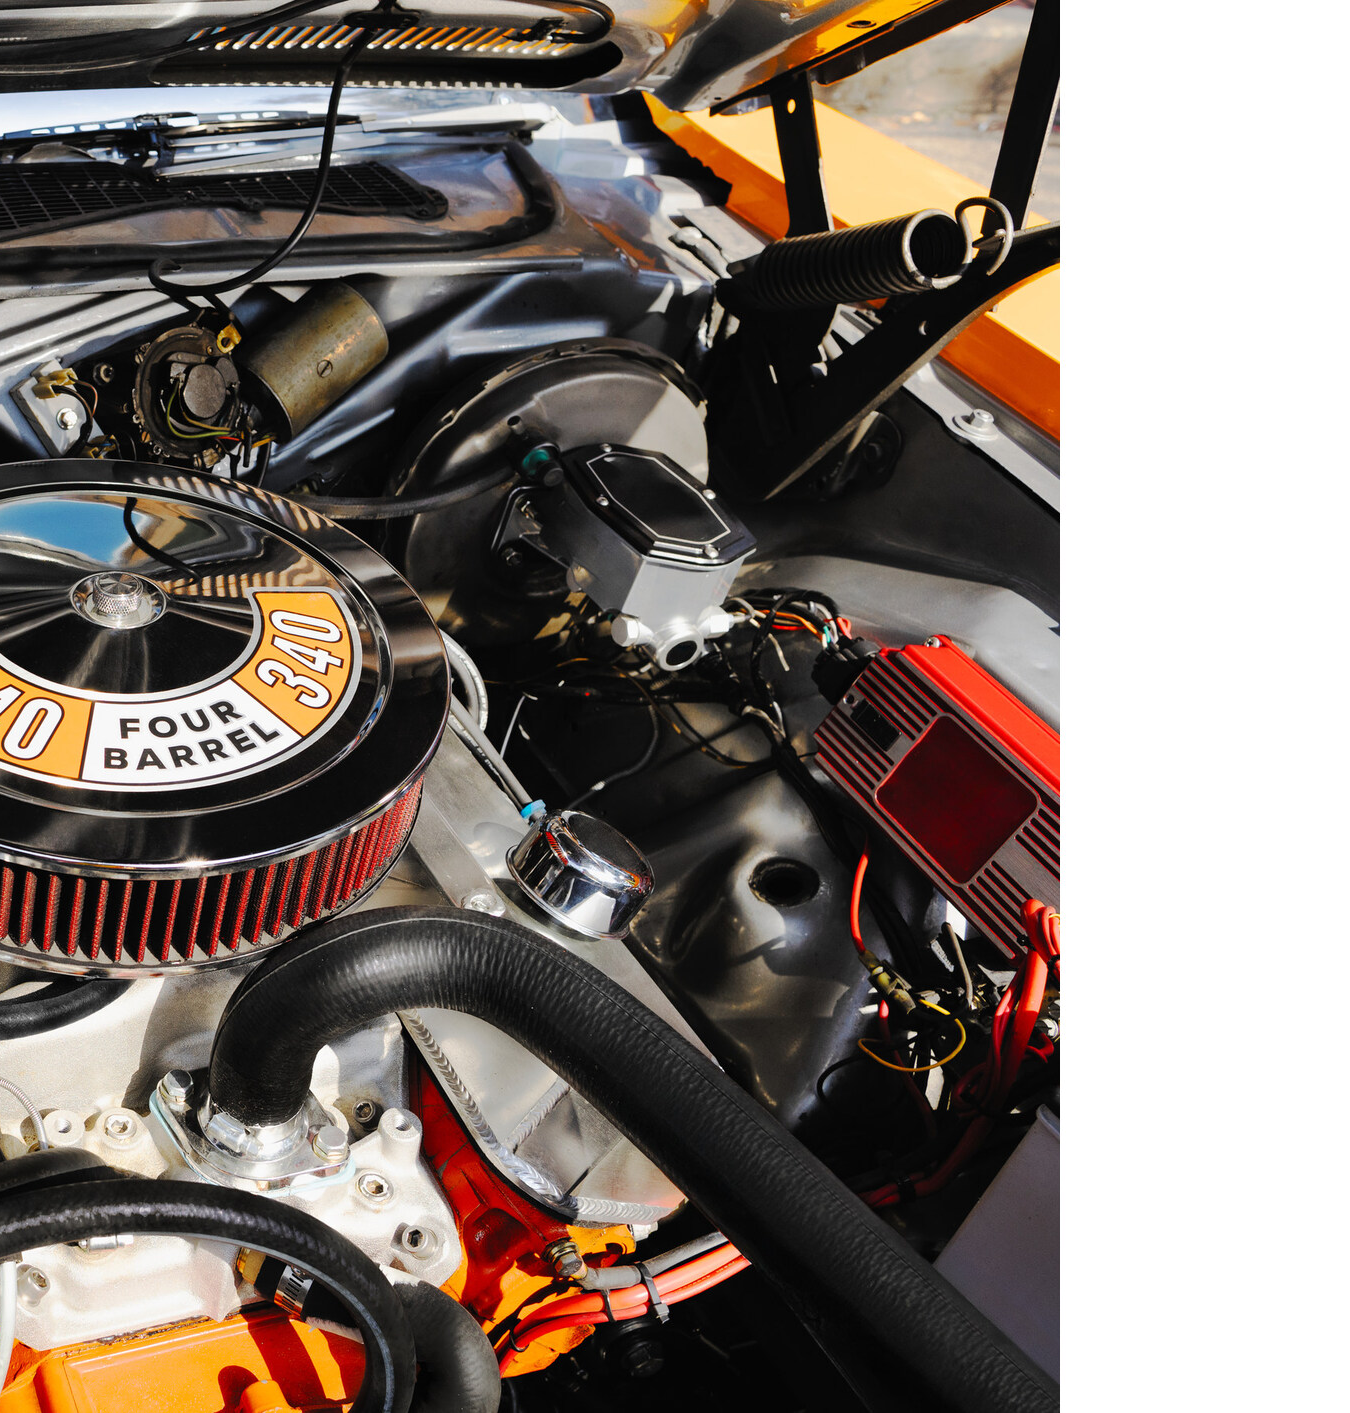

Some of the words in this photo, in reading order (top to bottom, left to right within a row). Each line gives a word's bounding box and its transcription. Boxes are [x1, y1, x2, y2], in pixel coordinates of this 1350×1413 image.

[254, 609, 344, 709] 340
[119, 701, 243, 739] FOUR
[103, 722, 281, 770] BARREL
